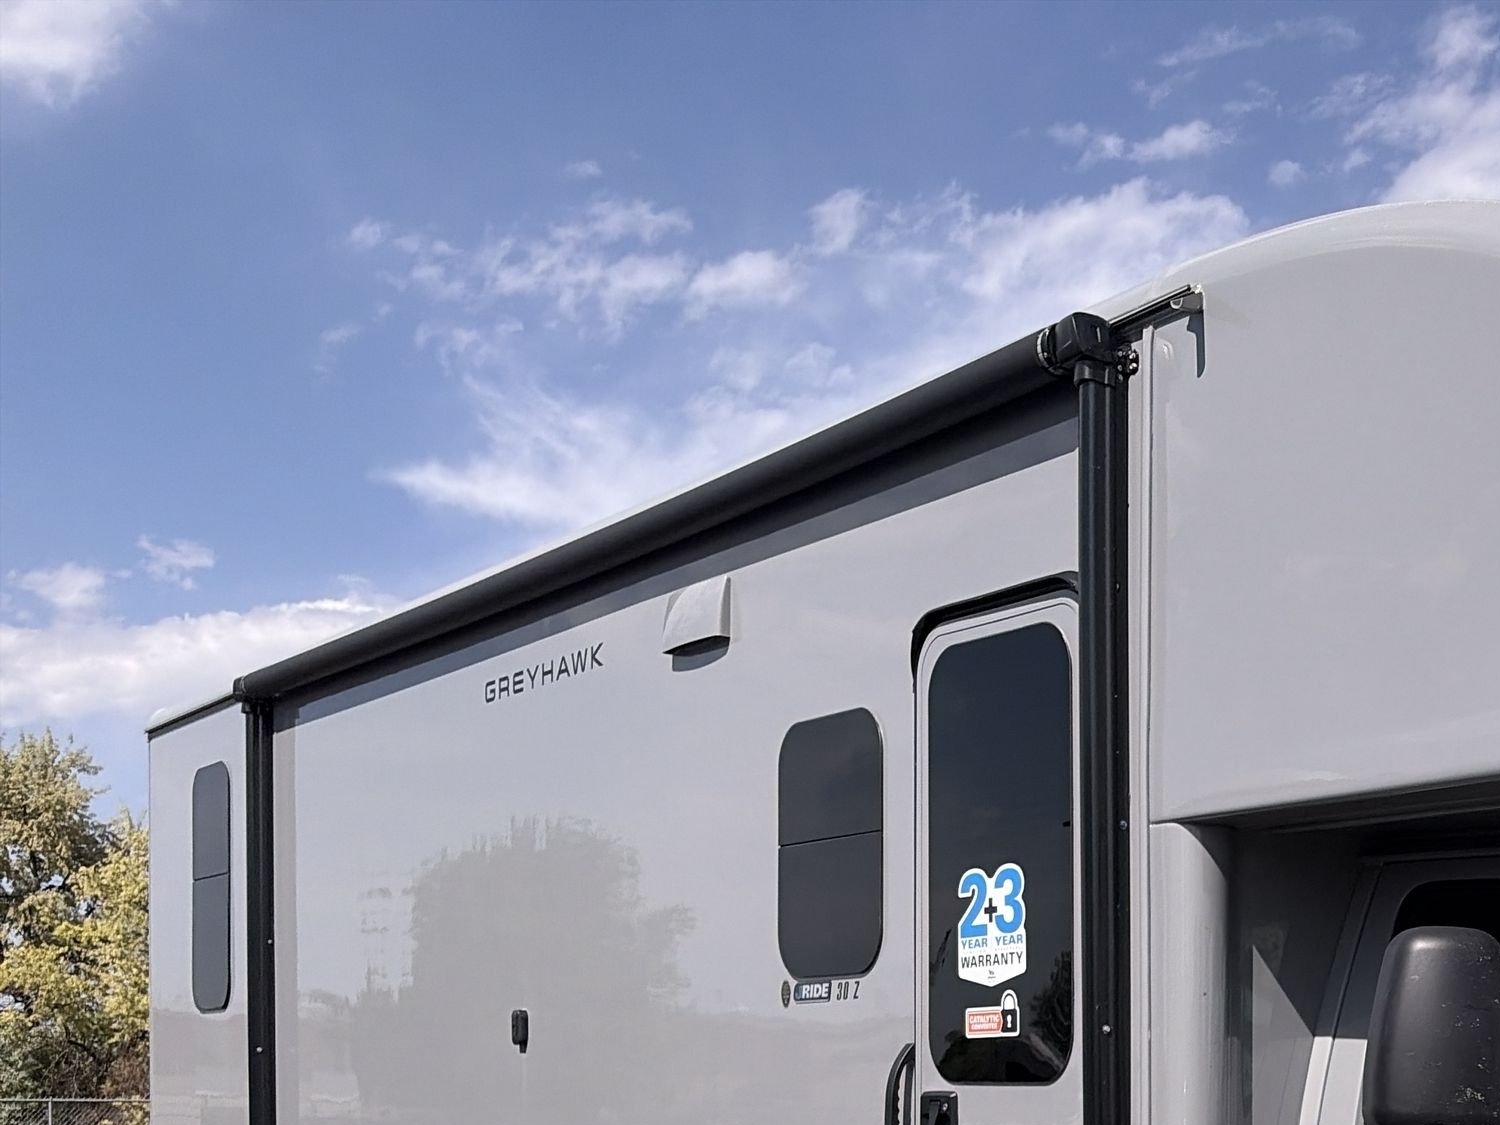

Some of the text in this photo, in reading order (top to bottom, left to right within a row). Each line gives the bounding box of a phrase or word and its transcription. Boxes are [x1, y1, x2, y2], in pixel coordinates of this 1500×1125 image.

[484, 642, 604, 704] GREYHAWK
[961, 938, 988, 950] YEAR
[994, 933, 1023, 946] YEAR
[961, 951, 1023, 969] WARRANTY
[836, 981, 849, 1001] 30
[853, 980, 860, 999] Z
[969, 1014, 1000, 1024] CATALYTIC
